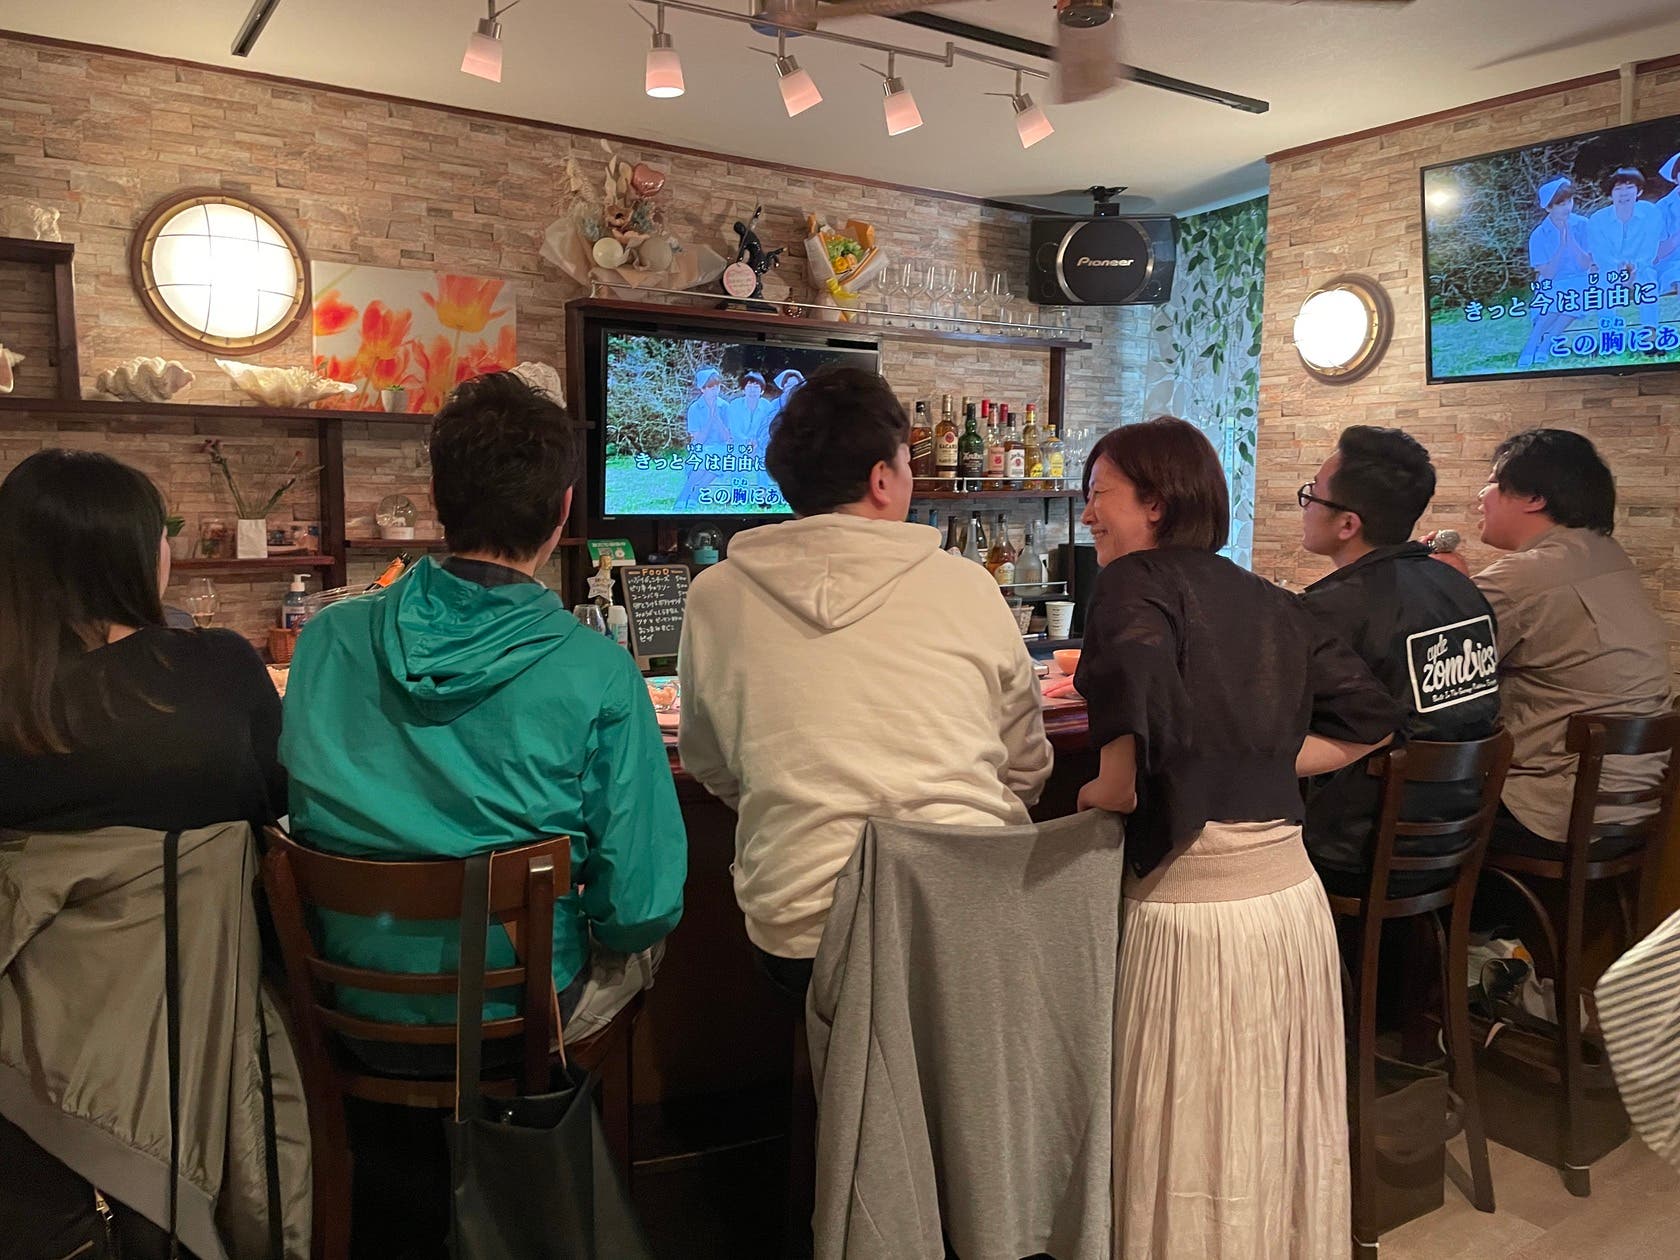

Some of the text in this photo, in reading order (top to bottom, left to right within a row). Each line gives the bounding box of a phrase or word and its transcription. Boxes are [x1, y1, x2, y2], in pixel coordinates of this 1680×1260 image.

[1077, 256, 1134, 267] Pioneer
[1530, 280, 1553, 291] いま
[1464, 282, 1658, 322] きっと今は自由に
[1550, 326, 1680, 357] この胸にあ
[634, 452, 767, 472] きっと今は自由に
[698, 487, 788, 506] この胸にあ
[641, 568, 670, 576] FOOD
